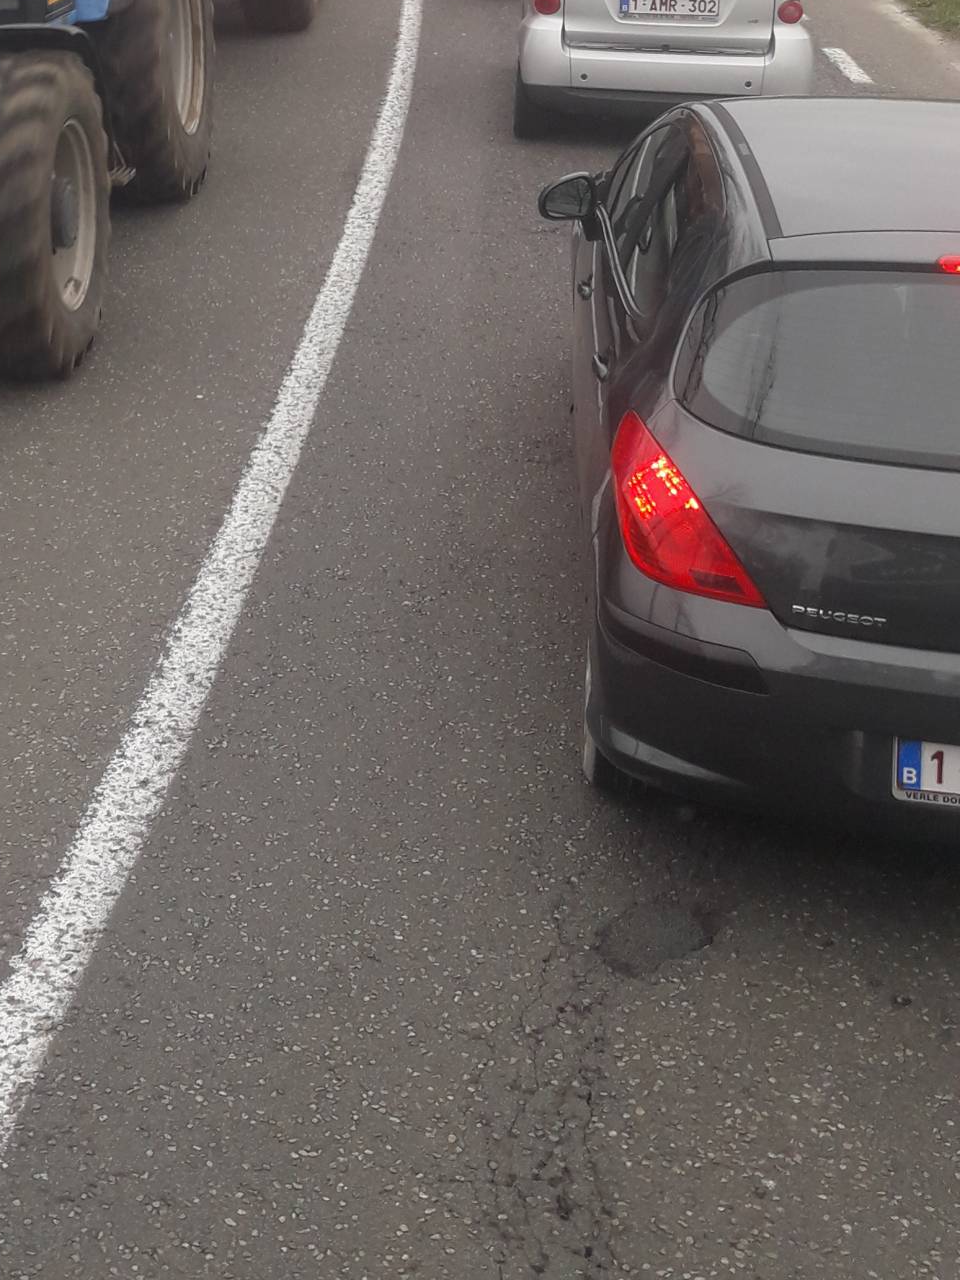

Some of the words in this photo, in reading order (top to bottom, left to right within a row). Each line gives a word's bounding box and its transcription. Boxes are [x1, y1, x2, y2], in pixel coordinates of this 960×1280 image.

[792, 604, 887, 627] PEUGEOT
[902, 767, 917, 784] B
[942, 795, 960, 805] DO
